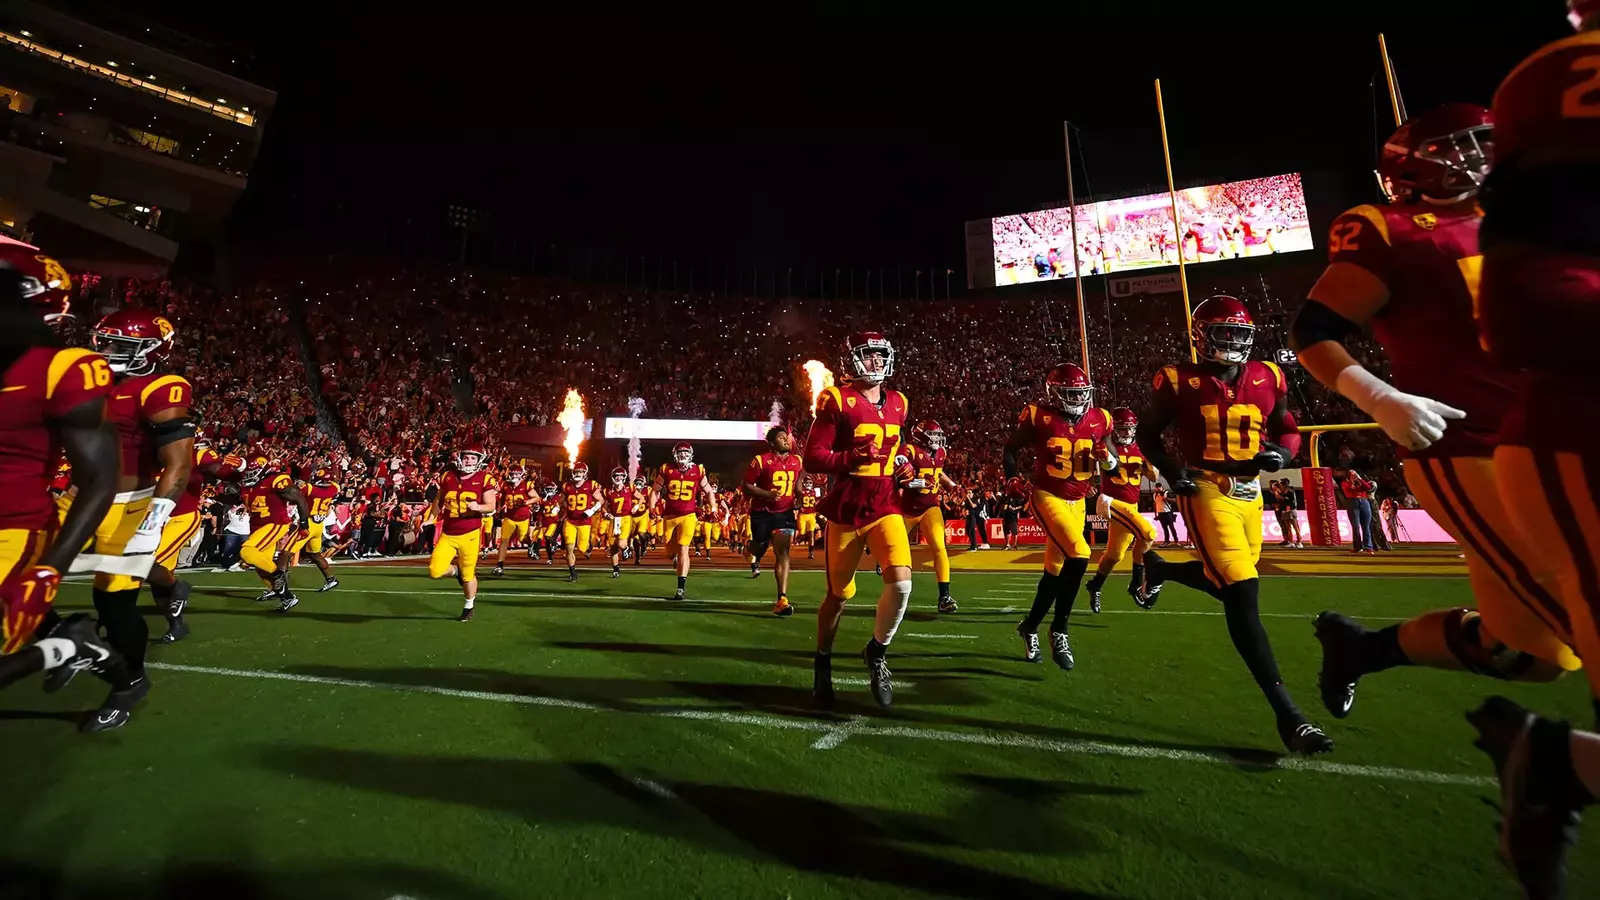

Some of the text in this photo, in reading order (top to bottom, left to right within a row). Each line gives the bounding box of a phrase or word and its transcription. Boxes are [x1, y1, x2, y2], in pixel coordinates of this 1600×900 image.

[78, 359, 110, 390] 16
[168, 386, 182, 403] 0
[1200, 404, 1263, 461] 10
[853, 424, 901, 476] 27
[1046, 437, 1095, 481] 30
[669, 480, 695, 501] 95
[772, 471, 795, 497] 91
[613, 497, 625, 514] 7
